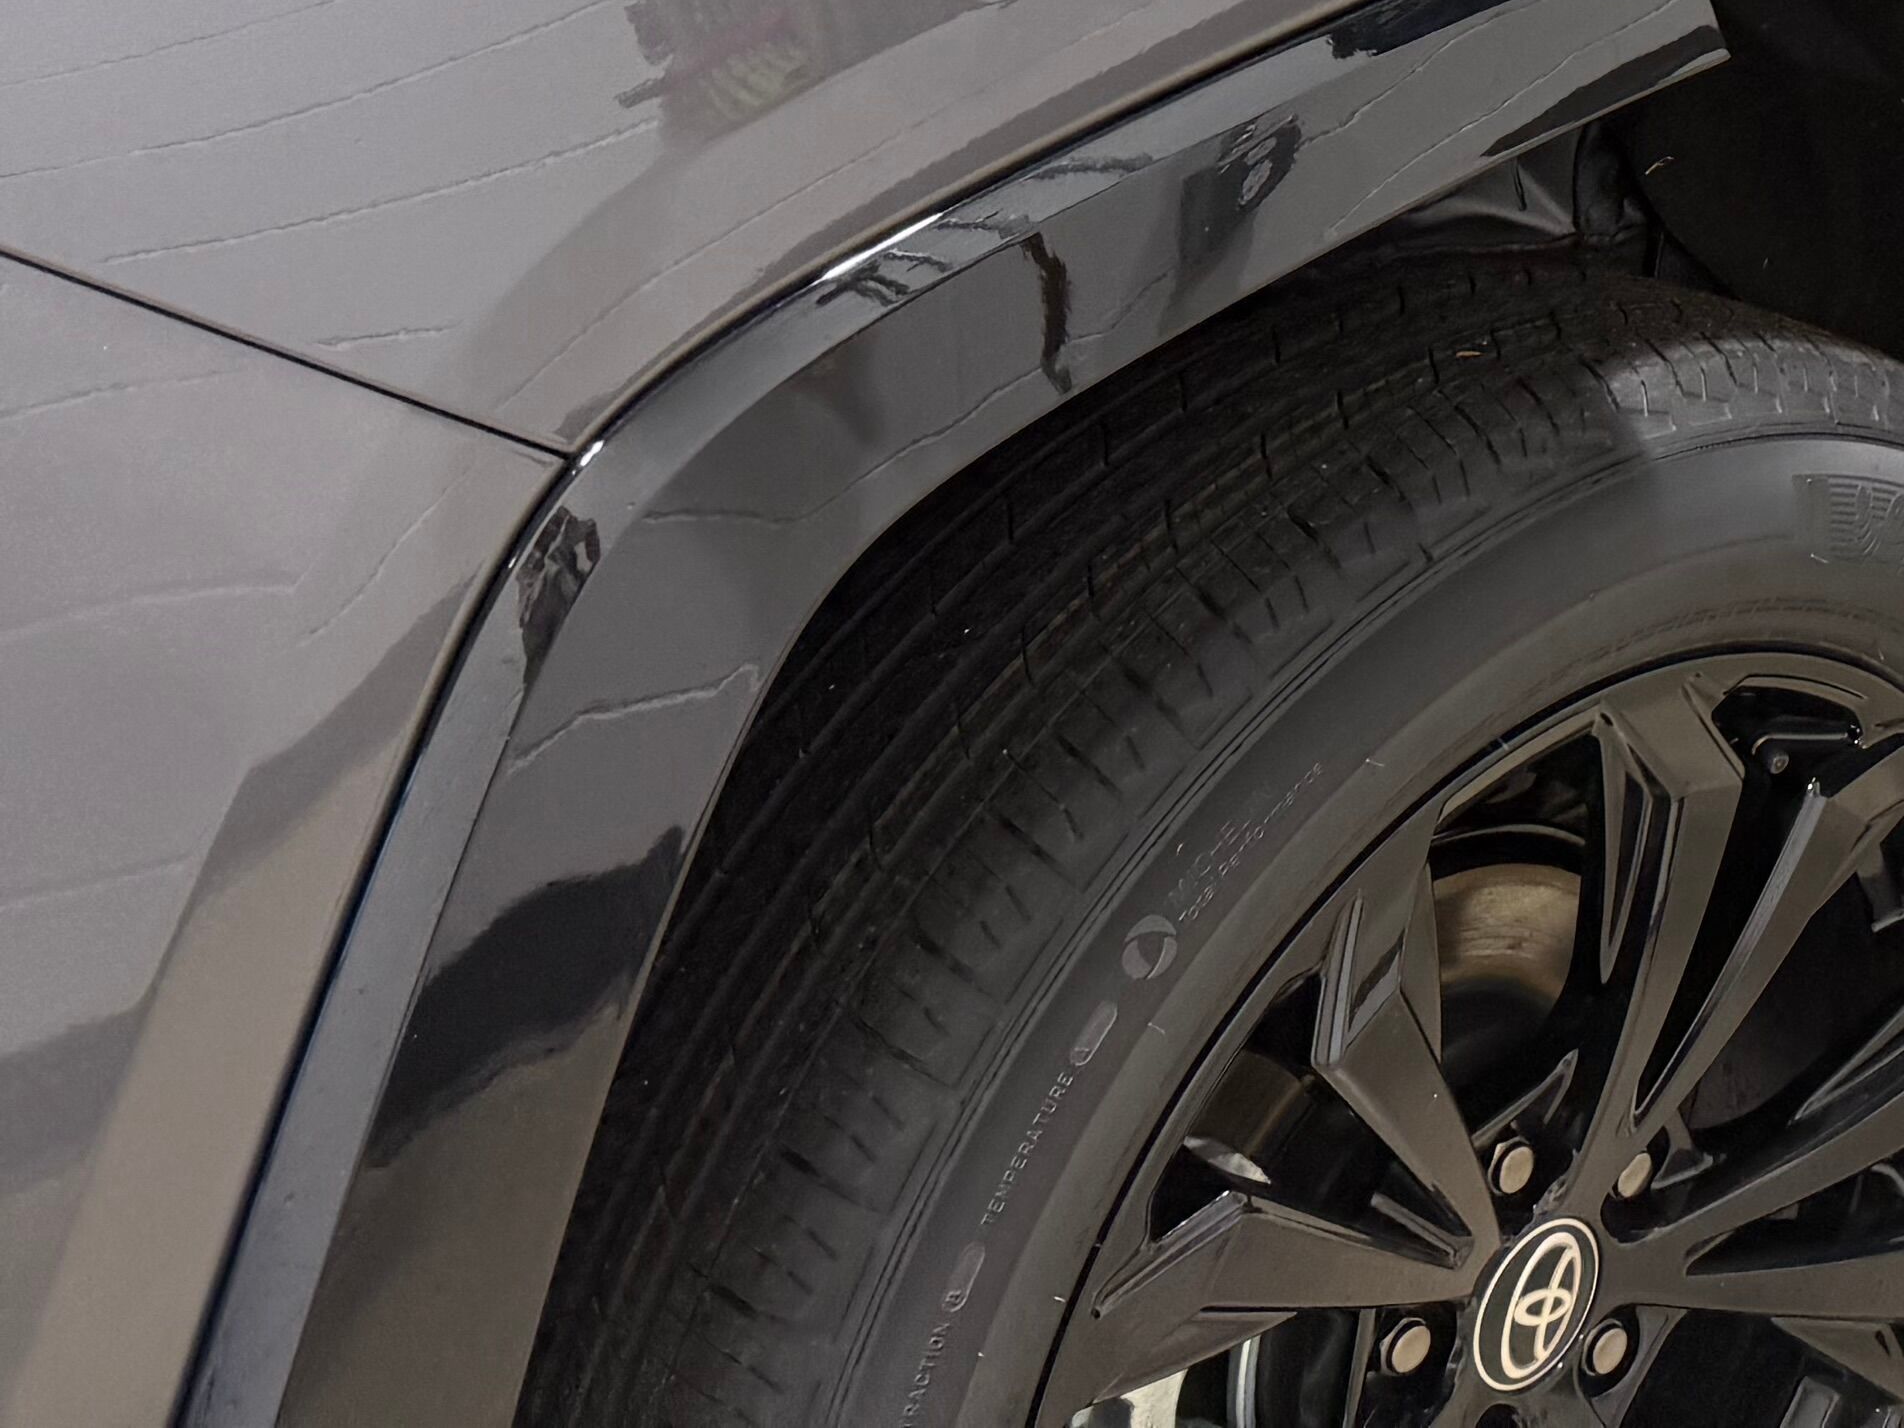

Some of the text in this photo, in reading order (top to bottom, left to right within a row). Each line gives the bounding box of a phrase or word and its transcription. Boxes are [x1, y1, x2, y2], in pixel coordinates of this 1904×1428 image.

[1178, 762, 1322, 922] Total Performance
[980, 1071, 1074, 1226] TEMPERATURE
